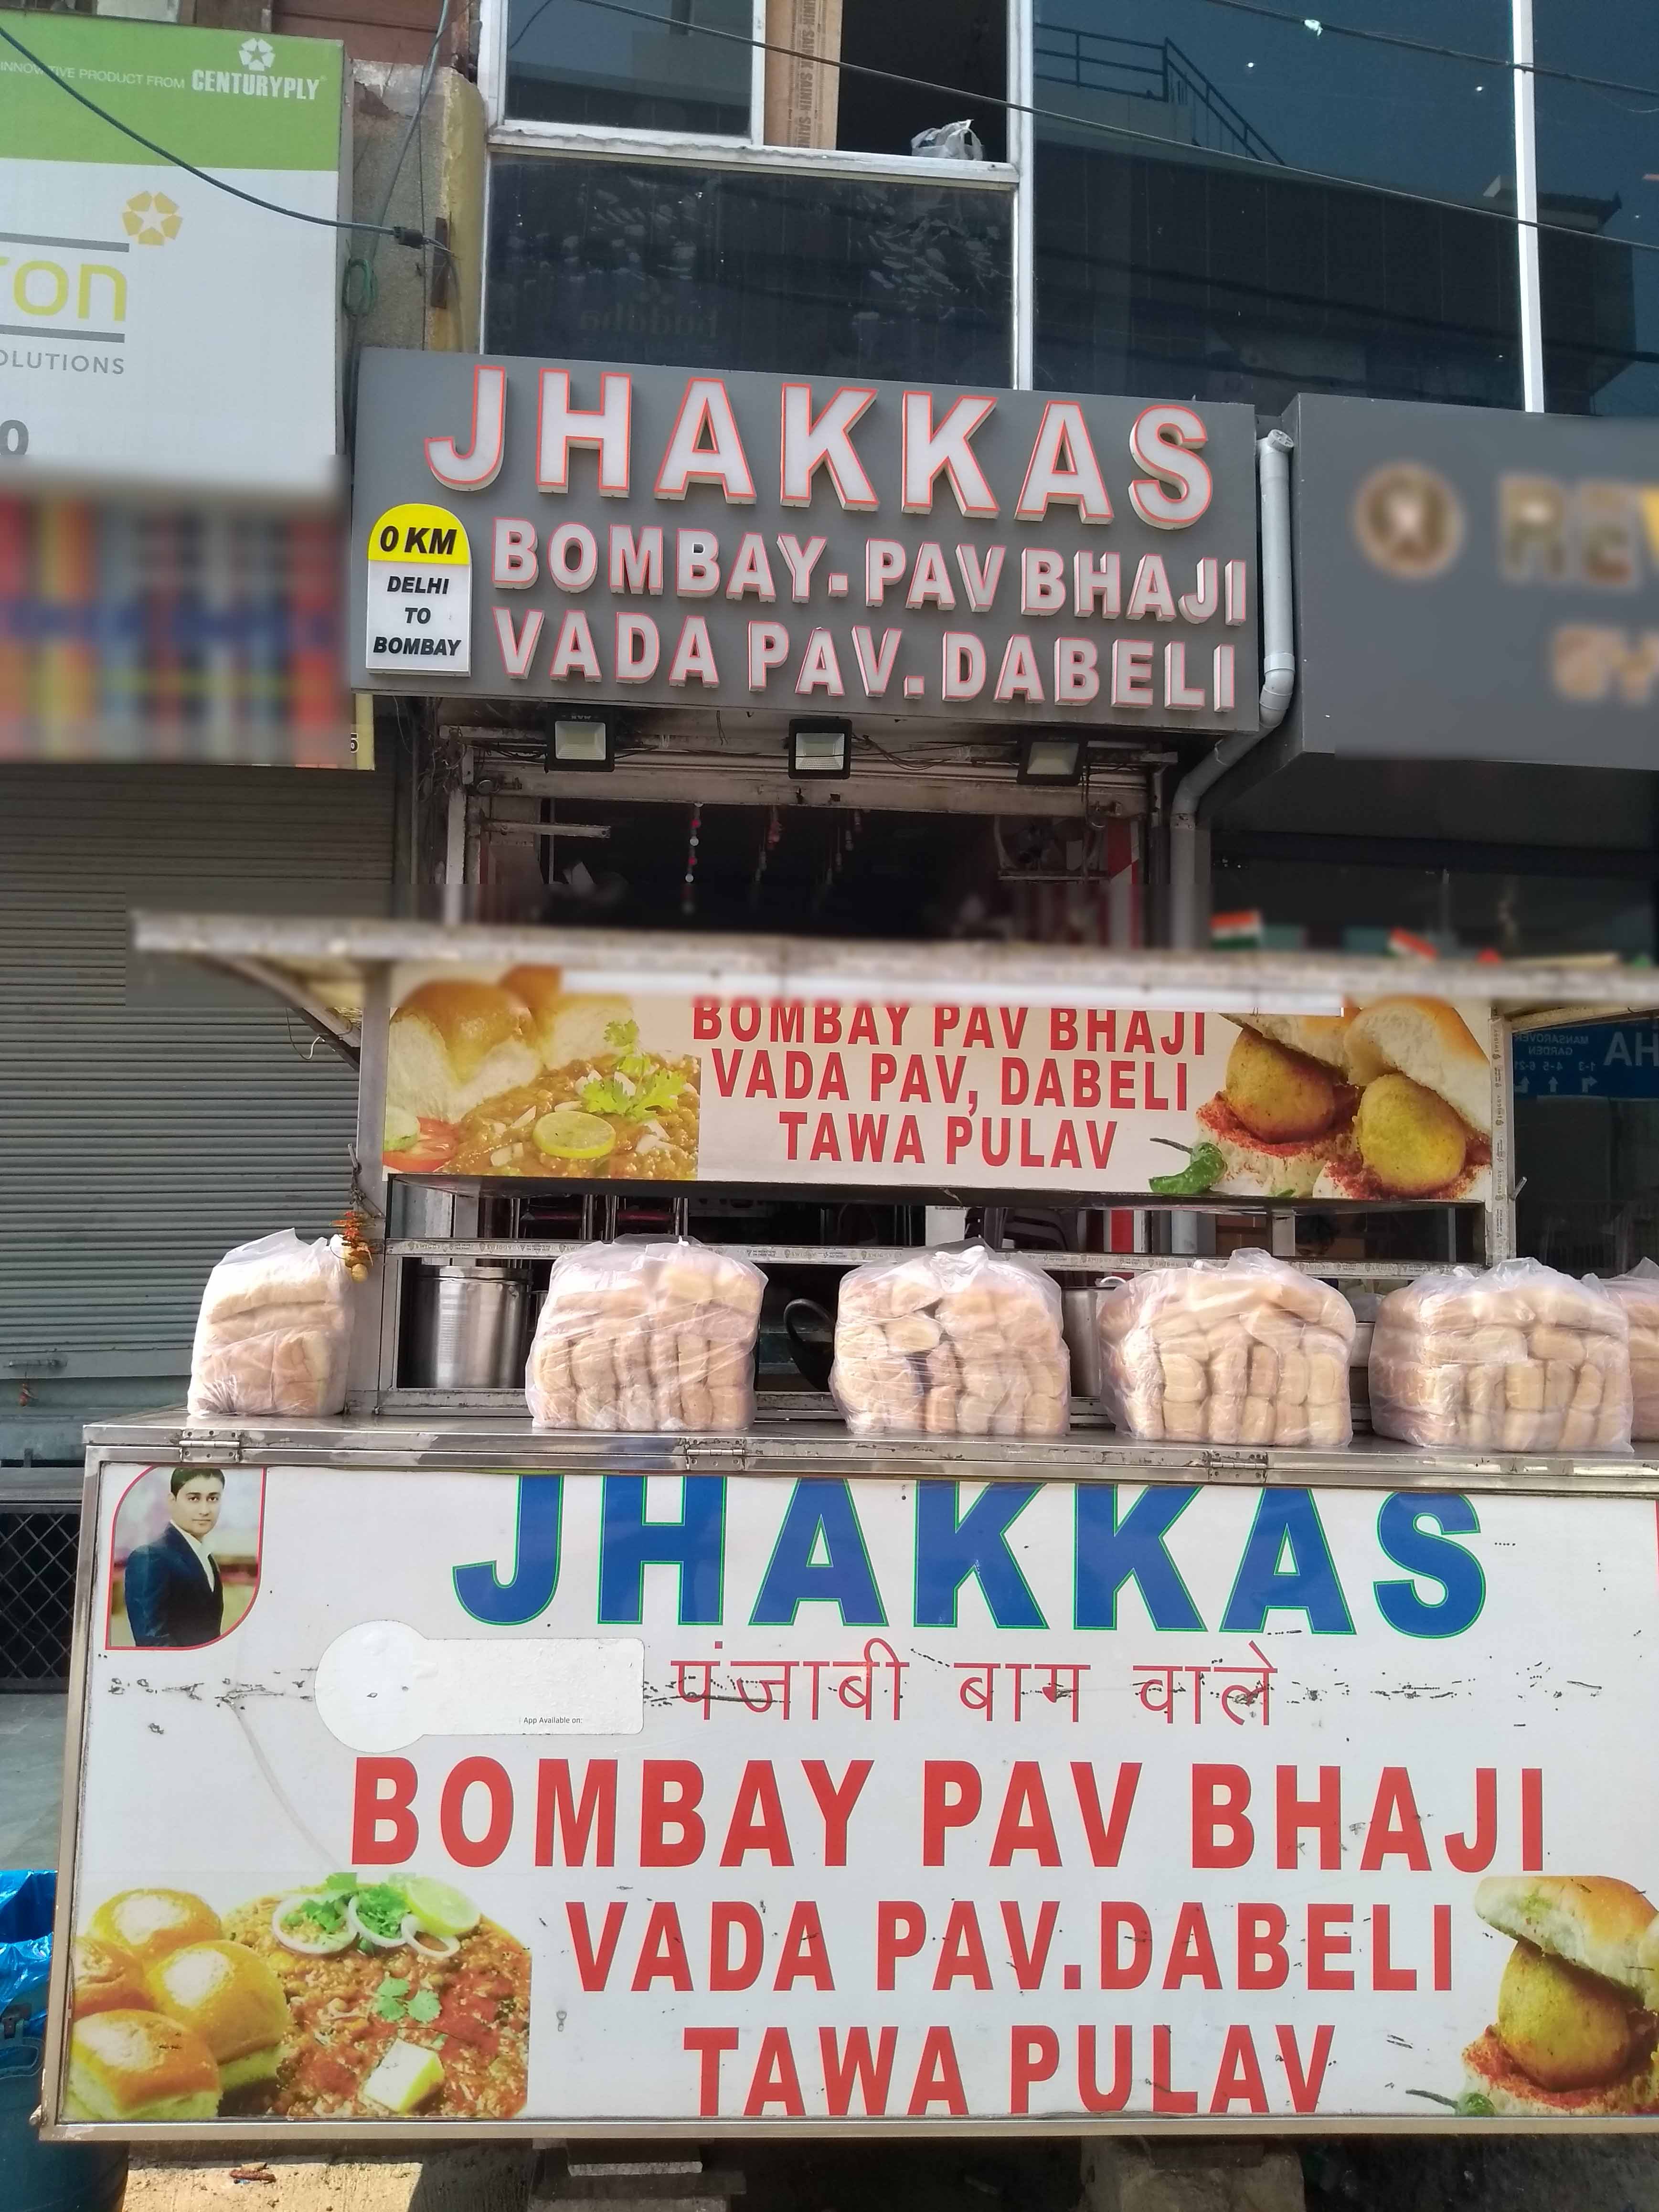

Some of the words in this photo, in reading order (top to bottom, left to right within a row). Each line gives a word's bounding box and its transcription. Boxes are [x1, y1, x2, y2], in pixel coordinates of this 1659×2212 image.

[0, 61, 75, 78] INNOVTIVE
[79, 68, 143, 85] PRODUCT
[146, 75, 185, 89] FROM
[192, 69, 319, 100] CENTURYPLY
[424, 365, 1213, 530] JHAKKAS
[380, 525, 399, 552] 0
[404, 527, 457, 555] KM
[387, 575, 449, 595] DELHI
[405, 607, 431, 624] TO
[1021, 548, 1246, 626] BHAJI
[373, 636, 462, 656] BOMBAY
[492, 607, 720, 689] VADA
[692, 996, 913, 1046] BOMBAY
[933, 1005, 1029, 1049] PAV
[1050, 1007, 1206, 1056] BHAJI
[711, 1048, 851, 1101] VADA
[1000, 1057, 1189, 1111] DABELI
[778, 1111, 926, 1164] TAWA
[945, 1114, 1117, 1170] PULAV
[453, 1474, 1487, 1639] JHAKKAS
[670, 1638, 910, 1721] पंजाबी
[1133, 1640, 1278, 1725] वाले
[523, 1717, 537, 1725] App
[351, 1755, 874, 1869] BOMBAY
[923, 1760, 1142, 1868] PAV
[1192, 1763, 1543, 1873] BHAJI
[565, 1901, 835, 1992] VADA
[683, 2025, 970, 2116] TAWA
[1010, 2024, 1336, 2115] PULAV
